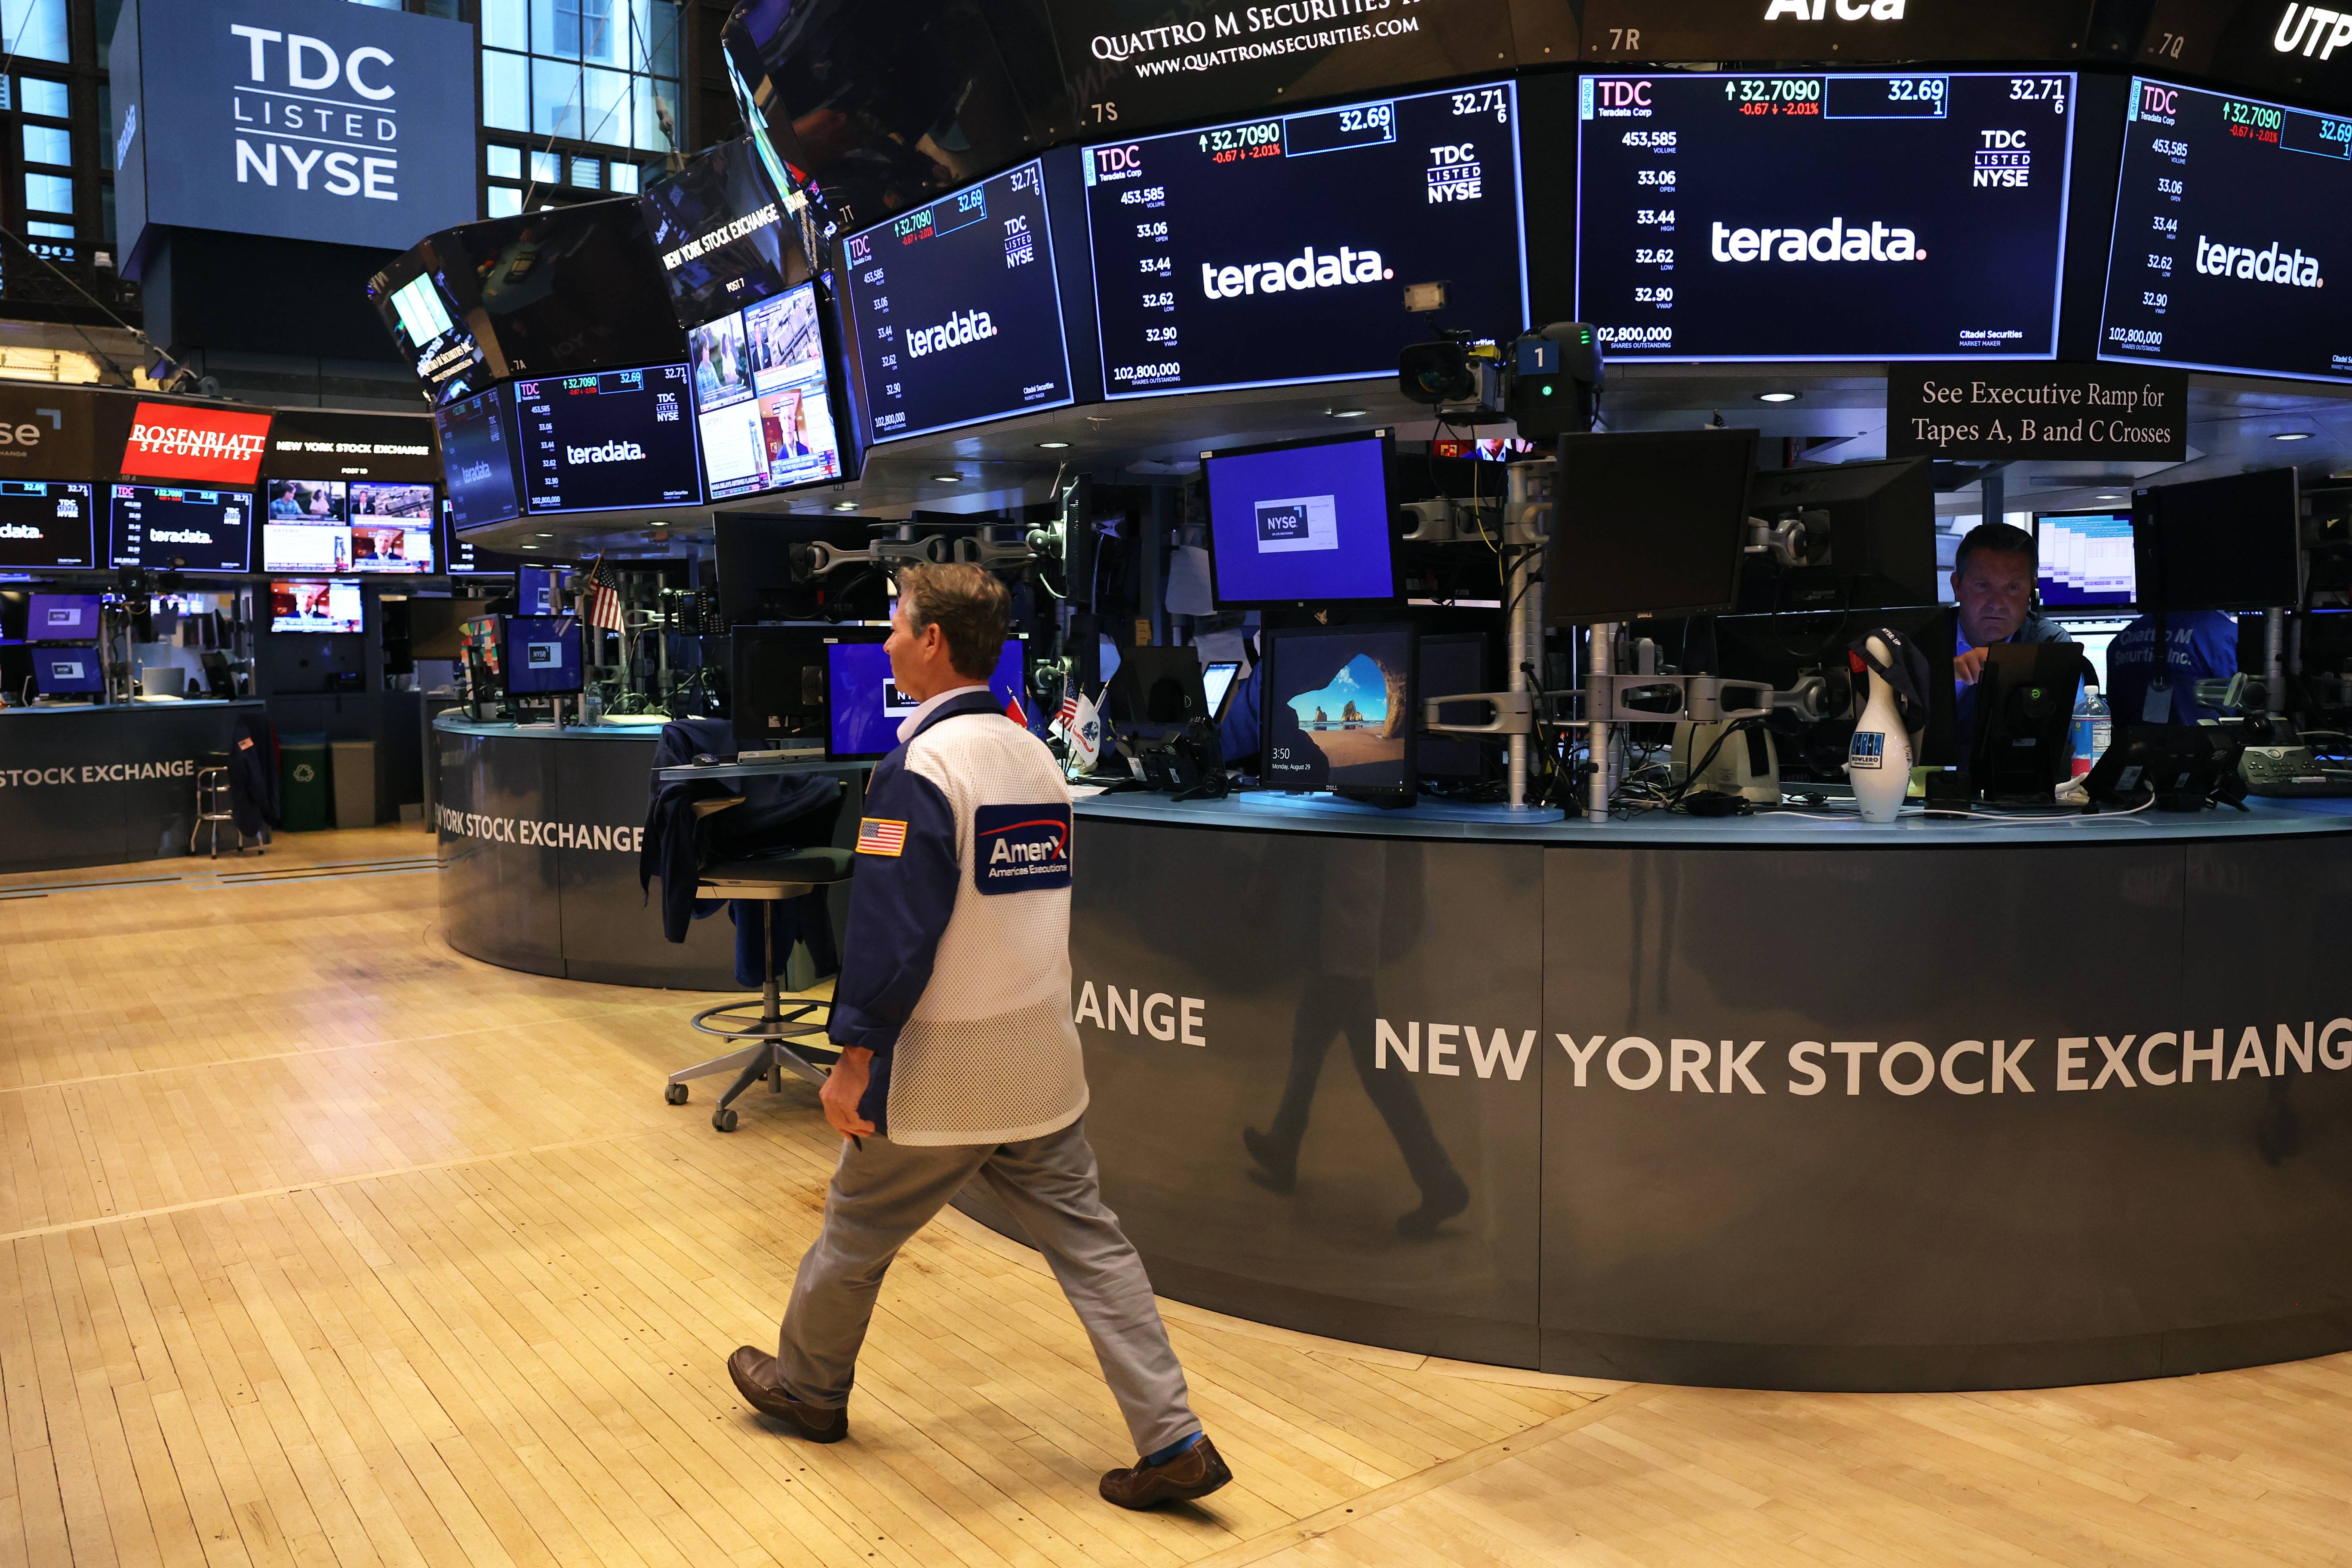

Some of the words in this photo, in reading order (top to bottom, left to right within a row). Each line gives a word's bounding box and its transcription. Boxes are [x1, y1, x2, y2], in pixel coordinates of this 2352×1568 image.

[1091, 22, 1205, 65] QUATTRO
[1215, 12, 1241, 38] M
[1132, 13, 1419, 78] WWW.QUATTROMSECURITIES.COM
[1609, 29, 1639, 50] 7R
[2159, 33, 2184, 59] 7Q
[231, 24, 396, 101] TDC
[1599, 81, 1652, 106] TDC
[1740, 80, 1820, 101] 32.7090
[1888, 80, 1944, 101] 32.69
[2009, 80, 2065, 100] 32.71
[1452, 89, 1507, 115] 32.71
[1739, 103, 1769, 115] -0.67
[1782, 103, 1818, 114] -2.01%
[2144, 86, 2178, 114] TDC
[234, 97, 397, 141] LISTED
[1091, 102, 1118, 123] 7S
[1340, 105, 1391, 132] 32.69
[1598, 108, 1632, 117] Teradata
[1633, 108, 1652, 117] Corp
[2231, 103, 2281, 129] 32.7090
[1211, 123, 1279, 151] 32.7090
[1622, 132, 1676, 148] 453,585
[1981, 130, 2026, 148] TDC
[2319, 120, 2352, 143] 32.69
[1213, 150, 1237, 163] -0.67
[1249, 144, 1280, 158] -2.01%
[1430, 143, 1474, 165] TDC
[2152, 138, 2188, 157] 453,585
[1098, 145, 1141, 172] TDC
[1974, 154, 2030, 165] LISTED
[236, 139, 399, 201] NYSE
[1011, 166, 1039, 192] 32.71
[1099, 171, 1126, 181] Teradata
[1126, 169, 1142, 178] Corp
[1427, 167, 1481, 182] LISTED
[1638, 170, 1676, 185] 33.06
[1974, 169, 2029, 187] NYSE
[1428, 181, 1482, 204] NYSE
[2158, 178, 2183, 194] 33.06
[957, 189, 982, 212] 32.69
[1121, 186, 1165, 205] 453,585
[839, 205, 854, 222] 7T
[1637, 210, 1675, 224] 33.44
[900, 210, 932, 236] 32.7090
[1004, 215, 1027, 236] TDC
[1137, 221, 1168, 237] 33.06
[2152, 216, 2177, 232] 33.44
[662, 249, 682, 270] NEW
[679, 239, 705, 261] YORK
[701, 226, 732, 252] STOCK
[728, 203, 780, 240] EXCHANGE
[1005, 234, 1032, 251] LISTED
[850, 236, 870, 259] TDC
[1636, 249, 1673, 263] 32.62
[1006, 247, 1034, 269] NYSE
[1140, 257, 1171, 272] 33.44
[2147, 254, 2172, 270] 32.62
[726, 280, 741, 292] POST
[739, 278, 744, 287] 7
[864, 268, 884, 284] 453,585
[1143, 292, 1174, 307] 32.62
[1635, 287, 1673, 301] 32.90
[2143, 292, 2168, 307] 32.90
[1146, 327, 1177, 341] 32.90
[1598, 327, 1672, 342] 02,800,000
[1960, 330, 1986, 338] Citadel
[1987, 330, 2023, 338] Securities
[2109, 327, 2162, 345] 102,800,000
[513, 360, 526, 370] 7A
[1535, 347, 1542, 367] 1
[1114, 362, 1180, 380] 102,800,000
[1149, 372, 1181, 384] OUTSTANDING
[568, 376, 596, 389] 32.7090
[1024, 385, 1036, 394] Citadel
[1036, 382, 1054, 391] Securities
[657, 393, 675, 403] TDC
[1923, 381, 1962, 403] See
[1971, 382, 2081, 404] Executive
[2087, 384, 2137, 412] Ramp
[2143, 384, 2164, 406] for
[657, 412, 679, 422] NYSE
[875, 412, 905, 427] 102,800,000
[130, 424, 265, 452] ROSENBLATT
[1912, 418, 1979, 447] Tapes
[1986, 419, 2012, 443] A,
[2020, 420, 2035, 440] B
[2044, 418, 2082, 441] and
[2089, 420, 2104, 442] C
[2110, 421, 2170, 443] Crosses
[140, 443, 251, 461] SECURITIES
[277, 441, 303, 451] NEW
[304, 442, 334, 452] YORK
[336, 443, 372, 453] STOCK
[373, 445, 429, 455] EXCHANGE
[117, 486, 134, 495] TDC
[2120, 628, 2172, 645] Quatto
[2174, 629, 2193, 644] M
[2168, 648, 2192, 665] Inc.
[1273, 748, 1290, 759] 3:50
[0, 767, 76, 787] STOCK
[82, 760, 194, 782] EXCHANGE
[442, 805, 464, 834] YORK
[466, 813, 515, 843] STOCK
[520, 820, 644, 852] EXCHANGE
[988, 834, 1067, 865] AmerX
[988, 867, 1029, 877] Americas
[1029, 864, 1067, 874] Executions
[1074, 981, 1206, 1047] ANGE
[1375, 1018, 1537, 1080] NEW
[1555, 1034, 1766, 1094] YORK
[1788, 1039, 2035, 1096] STOCK
[2057, 1018, 2352, 1091] EXCHANG
